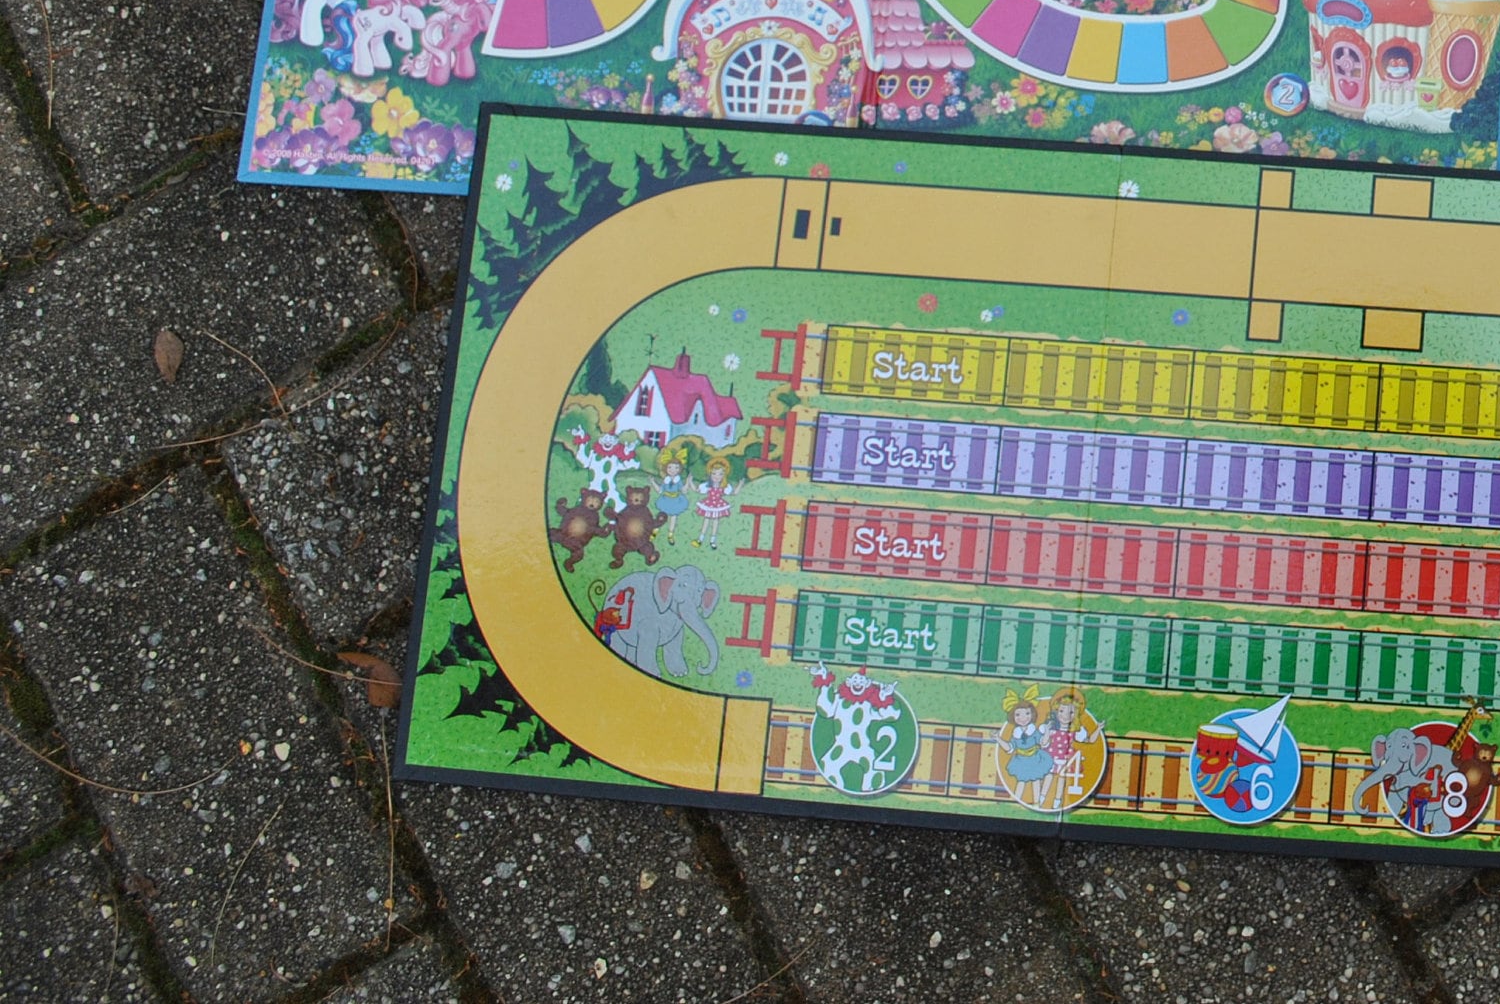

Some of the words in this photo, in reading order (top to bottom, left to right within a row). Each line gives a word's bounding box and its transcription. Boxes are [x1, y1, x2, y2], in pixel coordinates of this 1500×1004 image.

[1278, 83, 1295, 104] 2
[872, 352, 963, 385] Start
[863, 437, 955, 471] Start
[853, 527, 945, 561] Start
[844, 617, 936, 652] Start
[873, 725, 897, 772] 2
[1058, 750, 1084, 795] 4
[1248, 764, 1275, 811] 6
[1441, 771, 1468, 818] 8
